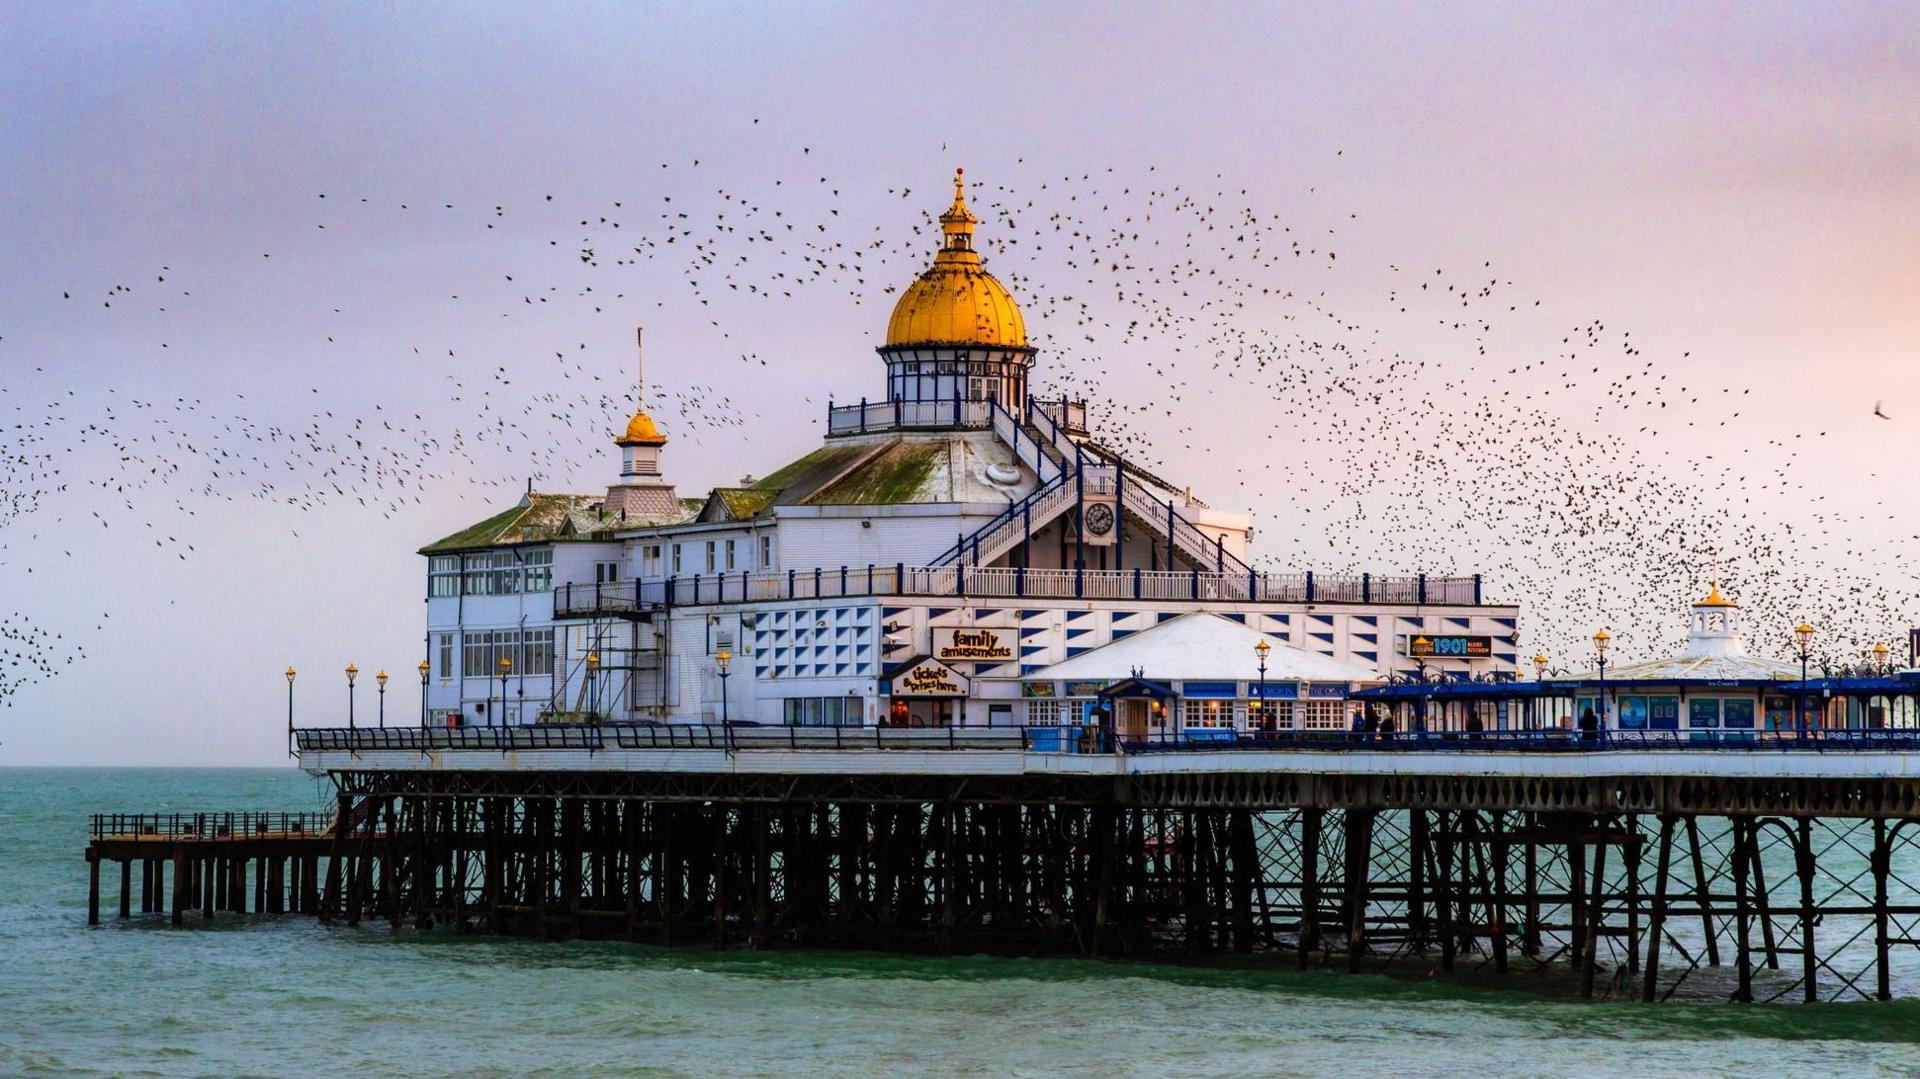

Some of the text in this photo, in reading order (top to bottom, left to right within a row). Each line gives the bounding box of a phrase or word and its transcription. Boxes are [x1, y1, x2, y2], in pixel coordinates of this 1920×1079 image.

[953, 630, 998, 649] family
[1433, 638, 1467, 653] 1901
[941, 646, 1011, 658] amusements
[912, 666, 947, 680] tickets
[903, 677, 911, 687] &
[936, 679, 958, 692] here
